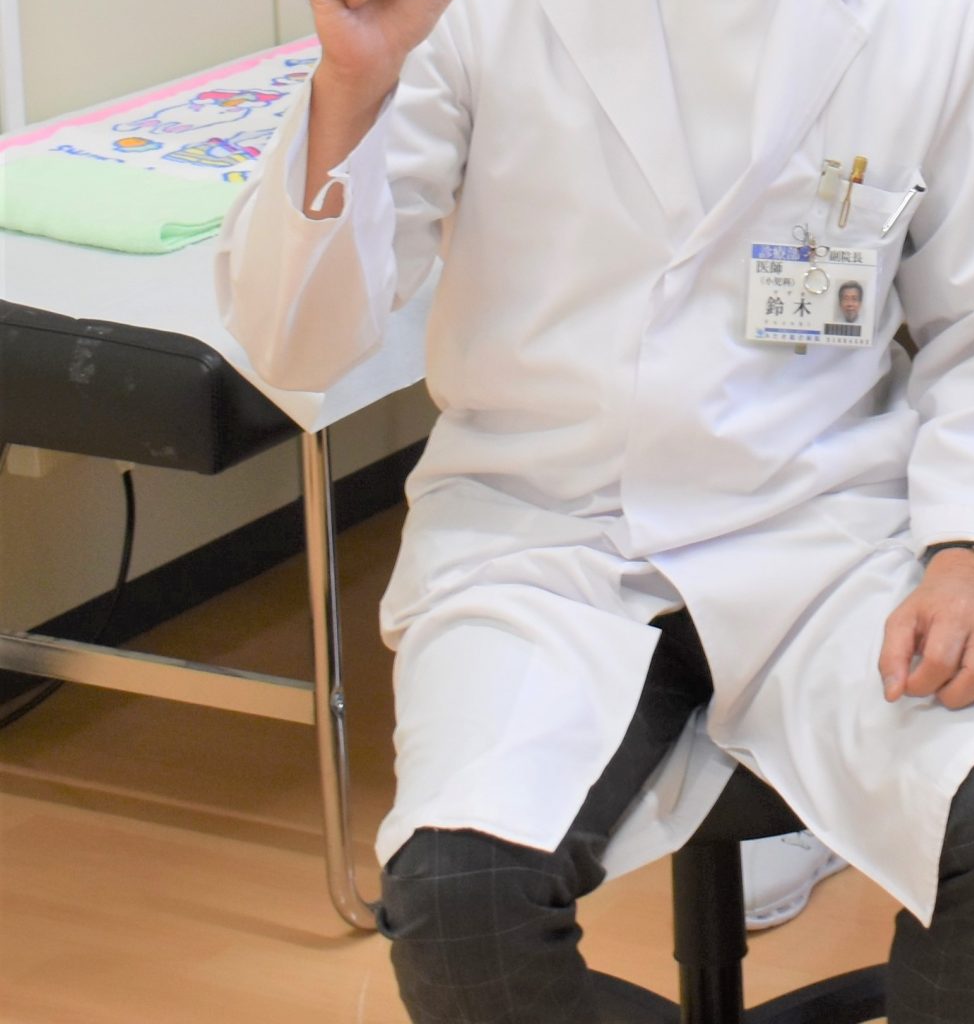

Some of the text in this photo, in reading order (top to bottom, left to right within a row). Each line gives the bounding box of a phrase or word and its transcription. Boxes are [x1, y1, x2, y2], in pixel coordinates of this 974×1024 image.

[829, 250, 863, 264] 副院長
[756, 261, 782, 274] 医師
[766, 296, 812, 317] 鈴木
